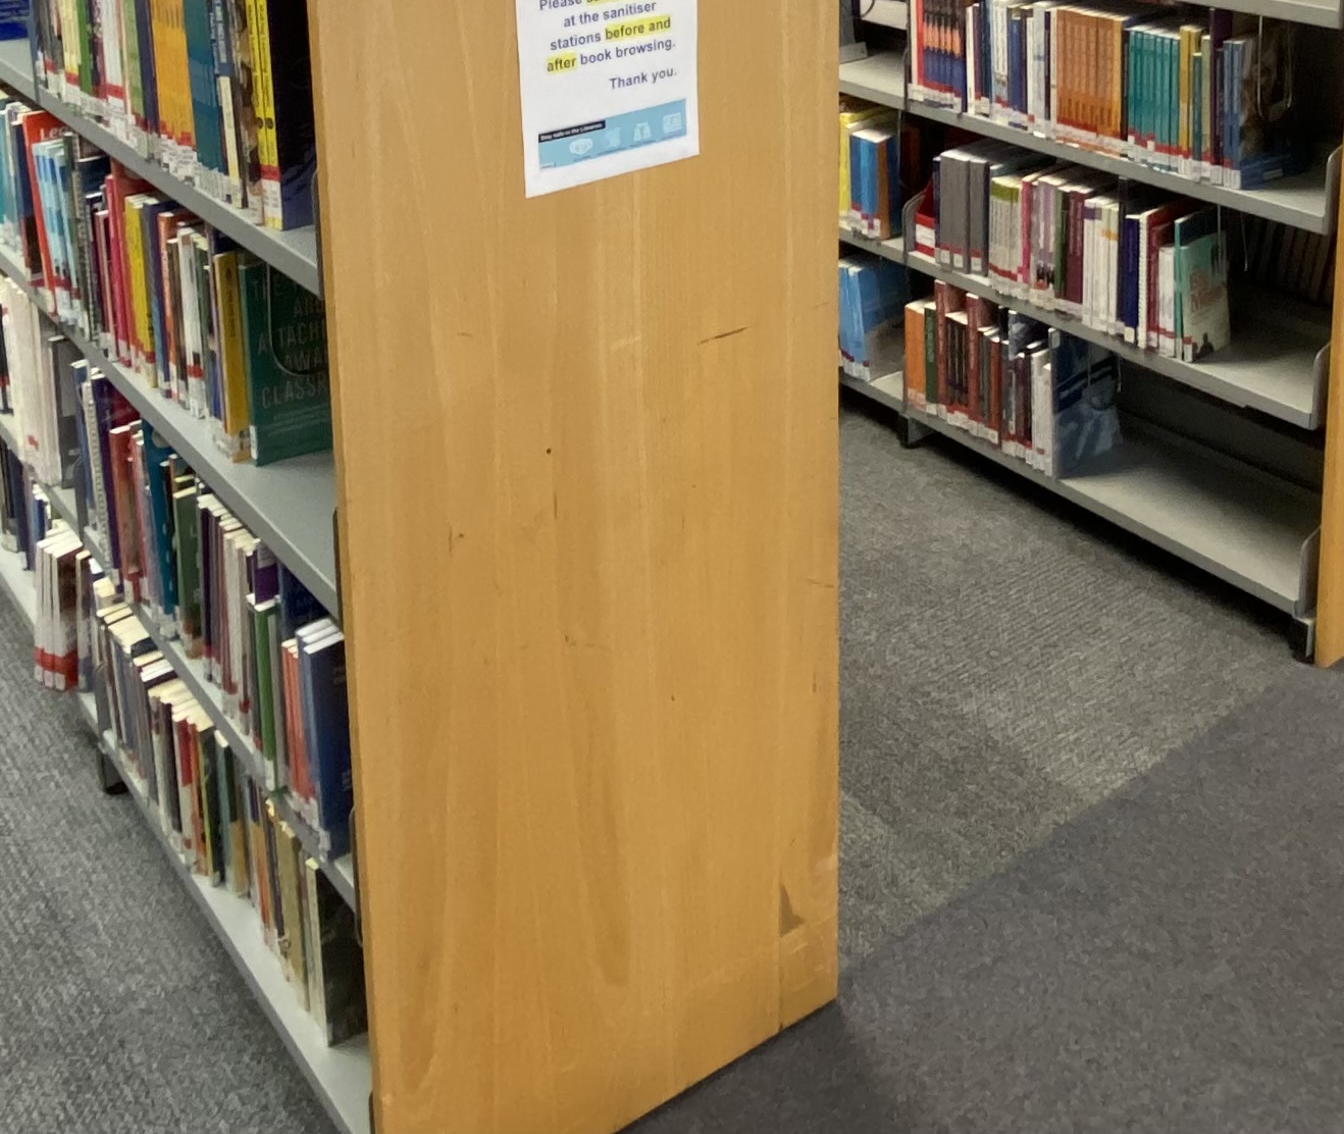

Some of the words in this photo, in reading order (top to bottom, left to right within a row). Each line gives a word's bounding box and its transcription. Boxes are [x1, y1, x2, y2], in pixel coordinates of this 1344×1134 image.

[563, 14, 576, 28] at
[579, 11, 599, 25] the
[603, 1, 657, 21] sanitiser
[550, 31, 602, 51] stations
[605, 24, 645, 41] before
[648, 17, 671, 33] and
[546, 56, 577, 73] after
[580, 50, 612, 66] book
[616, 39, 676, 59] browsing.
[609, 72, 648, 90] Thank
[652, 68, 677, 83] you.
